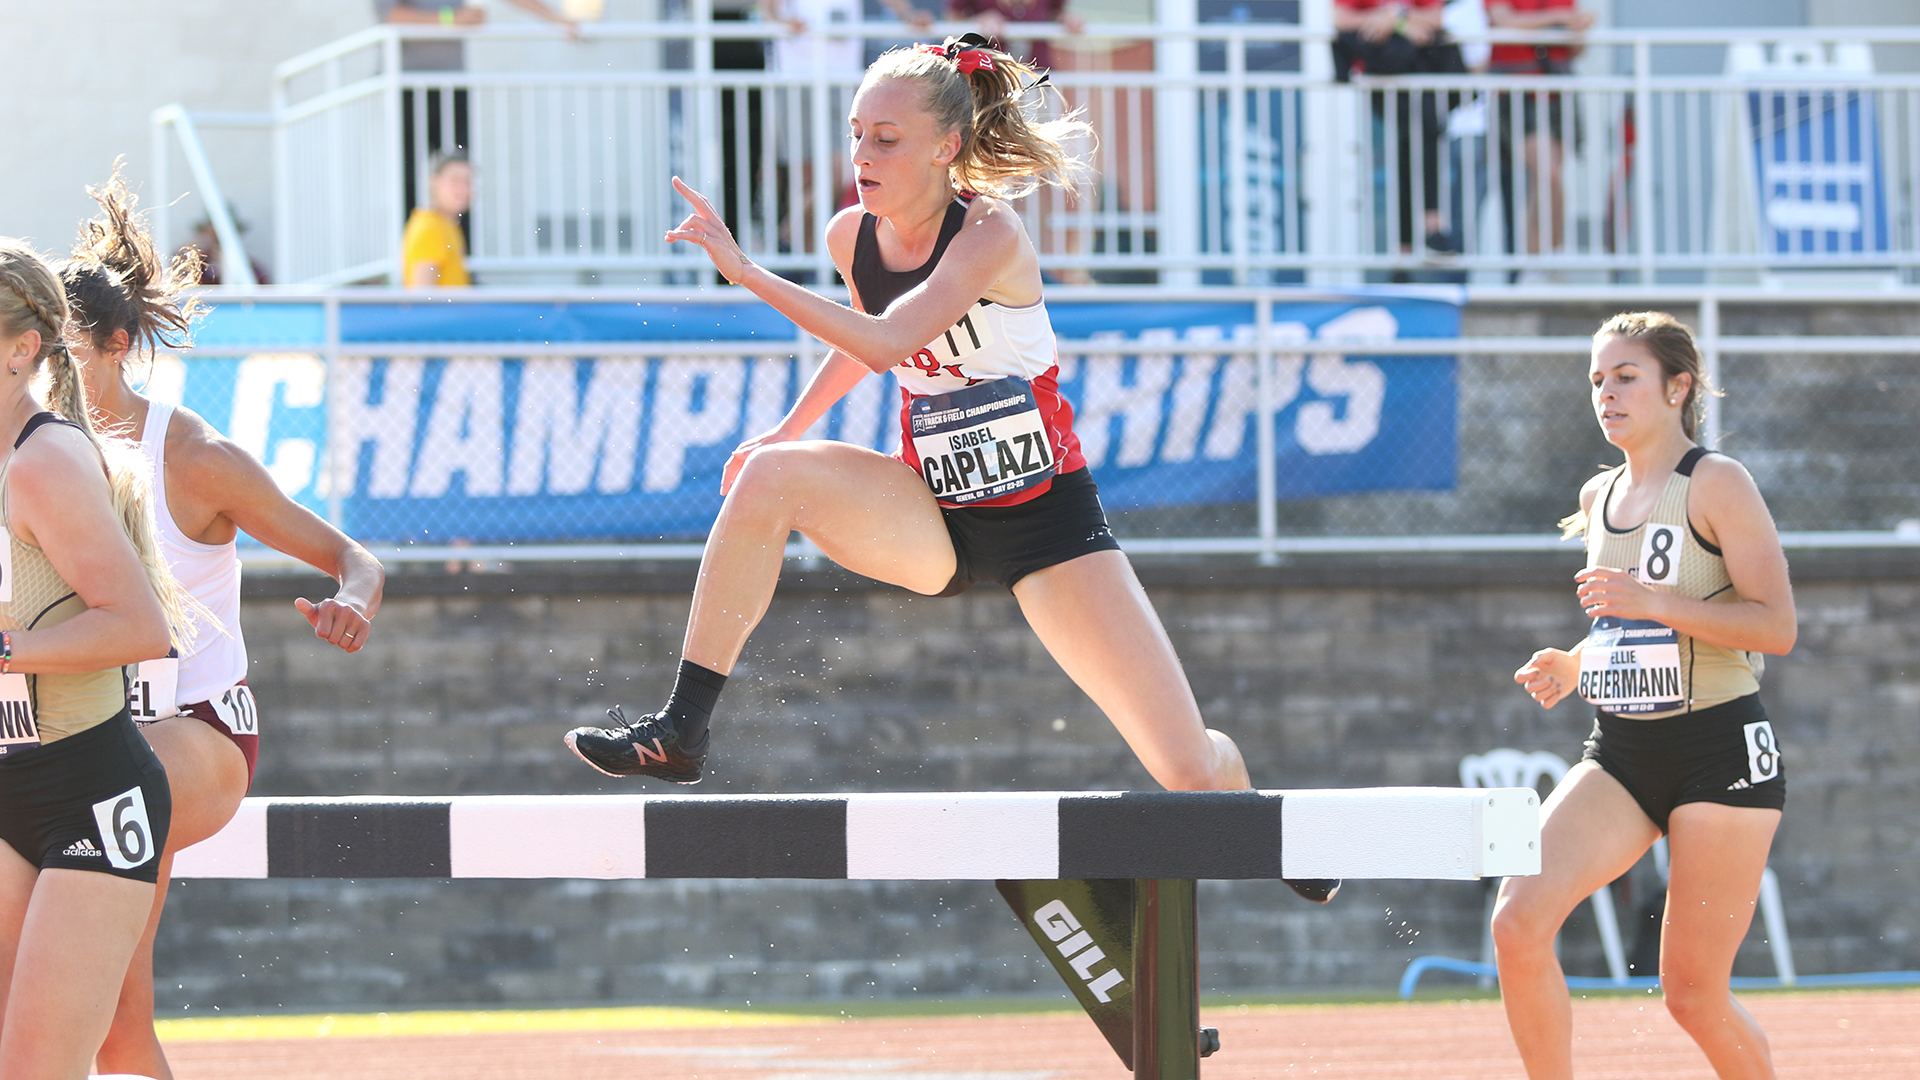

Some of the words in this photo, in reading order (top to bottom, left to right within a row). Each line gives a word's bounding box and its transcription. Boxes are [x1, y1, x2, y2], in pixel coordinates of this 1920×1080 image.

[228, 306, 1398, 499] CHAMPIHIPS
[924, 415, 943, 427] TRACK
[948, 410, 966, 423] FIELD
[966, 394, 1026, 418] CHAMPIONSHIPS
[948, 426, 996, 451] ISABEL
[923, 430, 1050, 495] CAPLAZI
[993, 485, 1006, 494] MAY
[1647, 528, 1674, 581] 8
[1611, 650, 1636, 665] ELLIE
[1581, 667, 1679, 699] BEIERMANN
[221, 687, 253, 732] 10
[1754, 726, 1773, 777] 8
[112, 796, 147, 863] 6
[63, 848, 102, 857] adidas
[1033, 899, 1125, 1004] GILL
